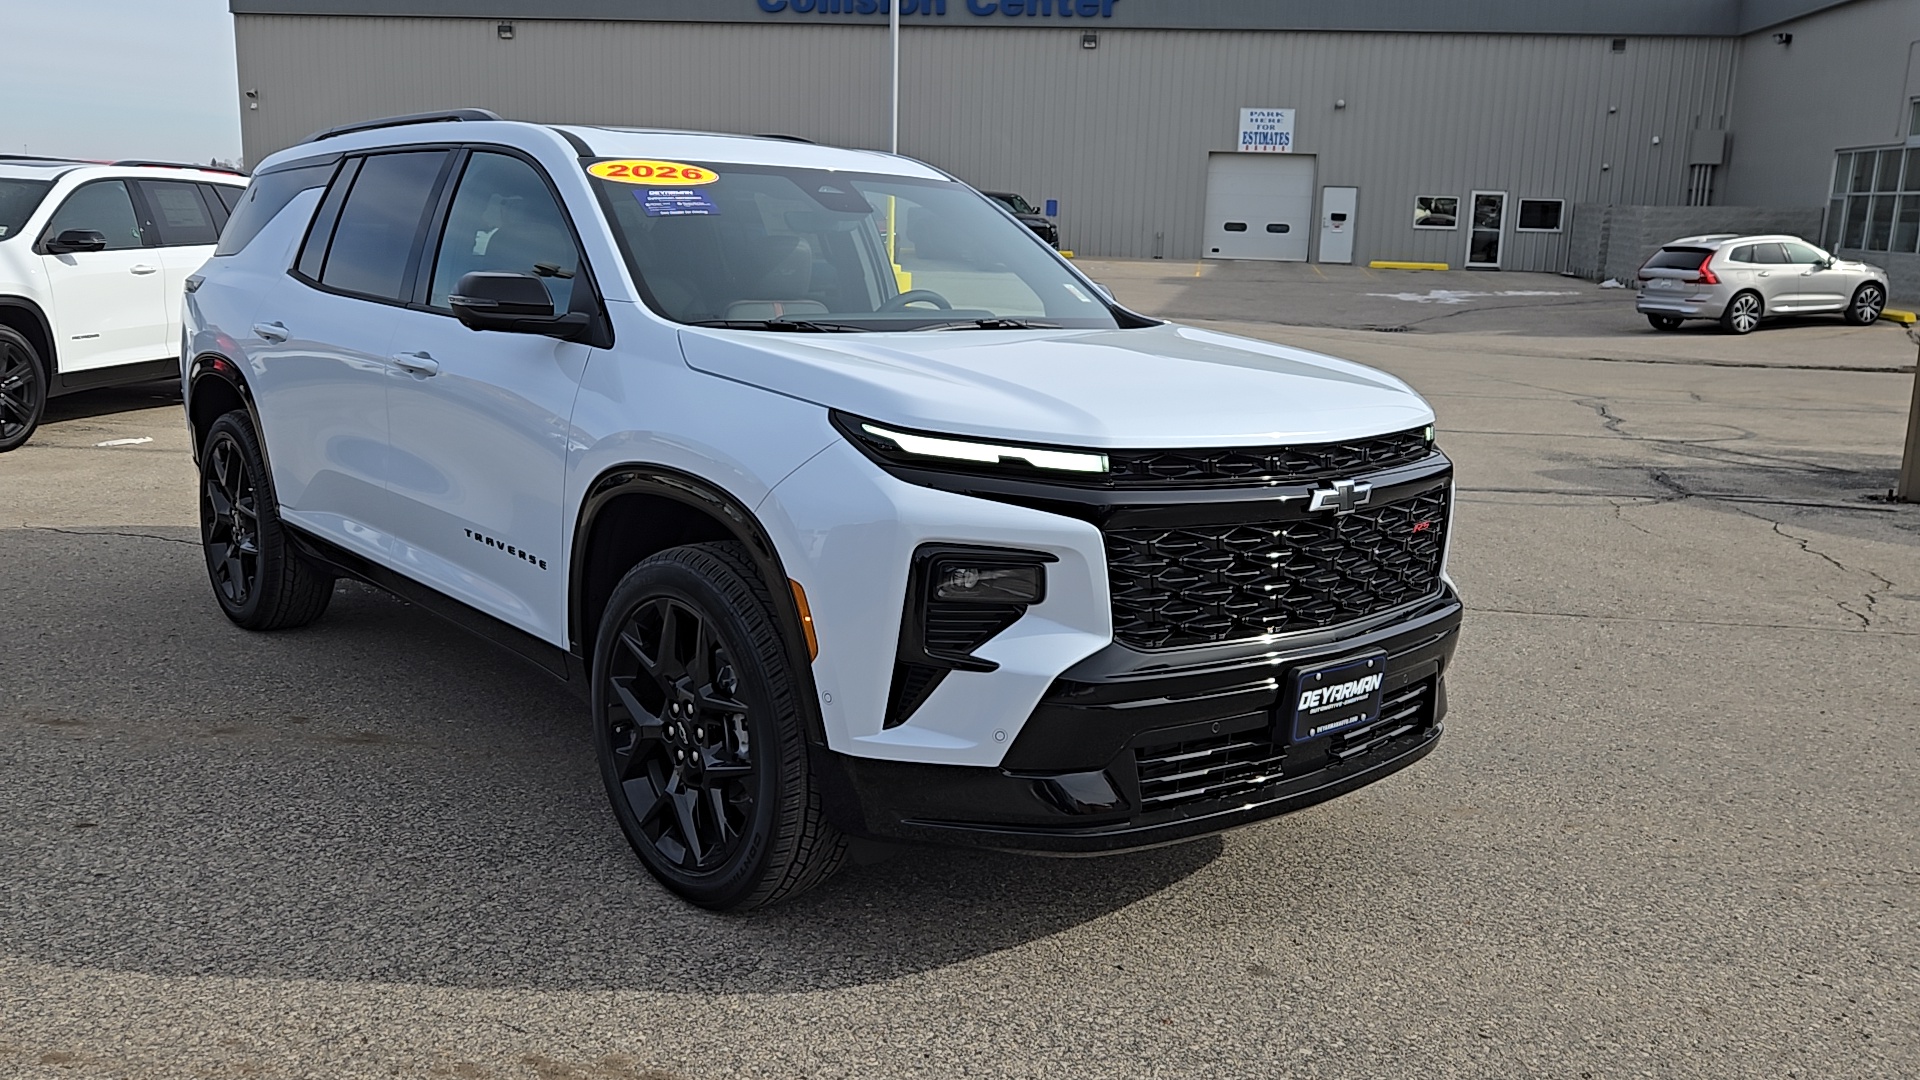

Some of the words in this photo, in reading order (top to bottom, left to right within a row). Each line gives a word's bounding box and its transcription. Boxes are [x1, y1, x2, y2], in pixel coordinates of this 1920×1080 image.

[1242, 131, 1290, 146] ESTIMATES
[606, 164, 703, 180] 2026
[1412, 520, 1430, 534] RS
[463, 528, 547, 571] TRAVERSE
[1297, 672, 1384, 711] DEYARMAN
